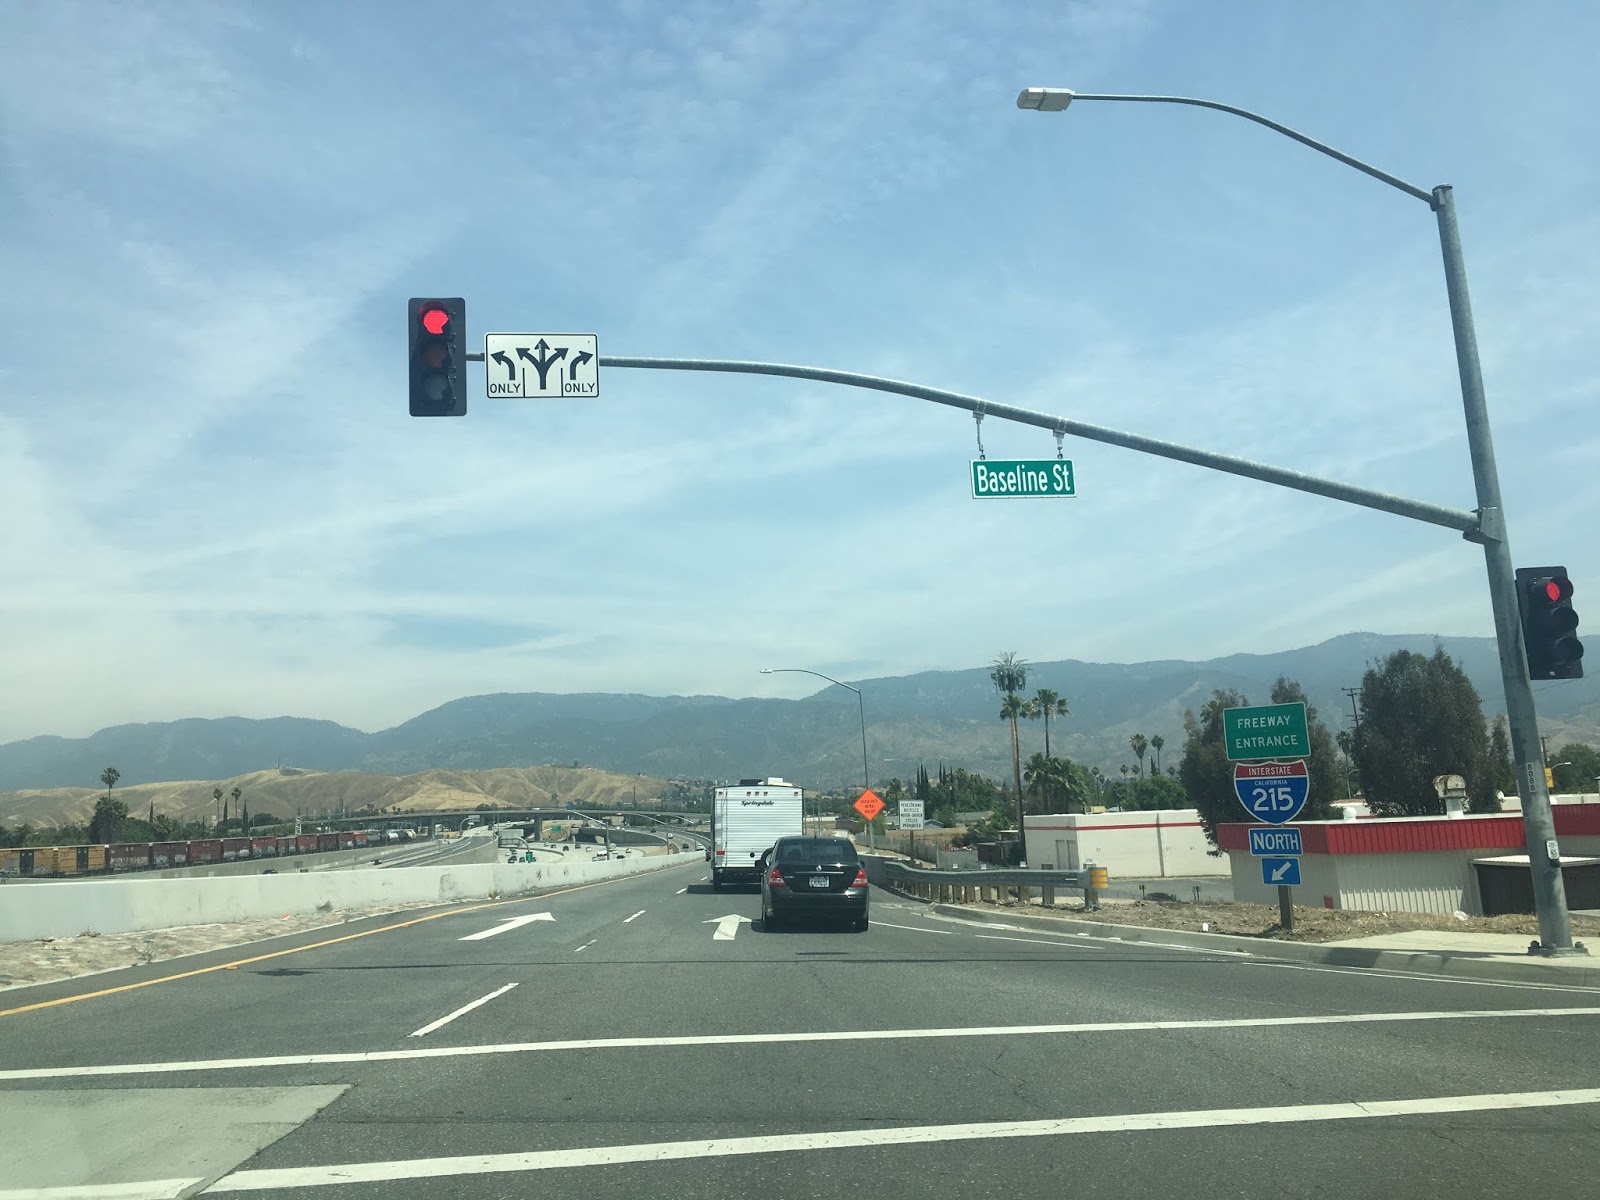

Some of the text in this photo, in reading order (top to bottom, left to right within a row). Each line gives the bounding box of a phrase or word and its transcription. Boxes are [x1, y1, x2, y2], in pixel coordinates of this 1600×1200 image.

[489, 383, 521, 394] ONLY
[564, 382, 596, 393] ONLY
[976, 463, 1071, 492] Baseline St
[1237, 714, 1291, 729] FREEWAY
[1235, 734, 1299, 749] ENTRANCE
[1248, 766, 1292, 776] INTERSTATE
[1252, 787, 1294, 811] 215
[1252, 832, 1299, 850] NORTH
